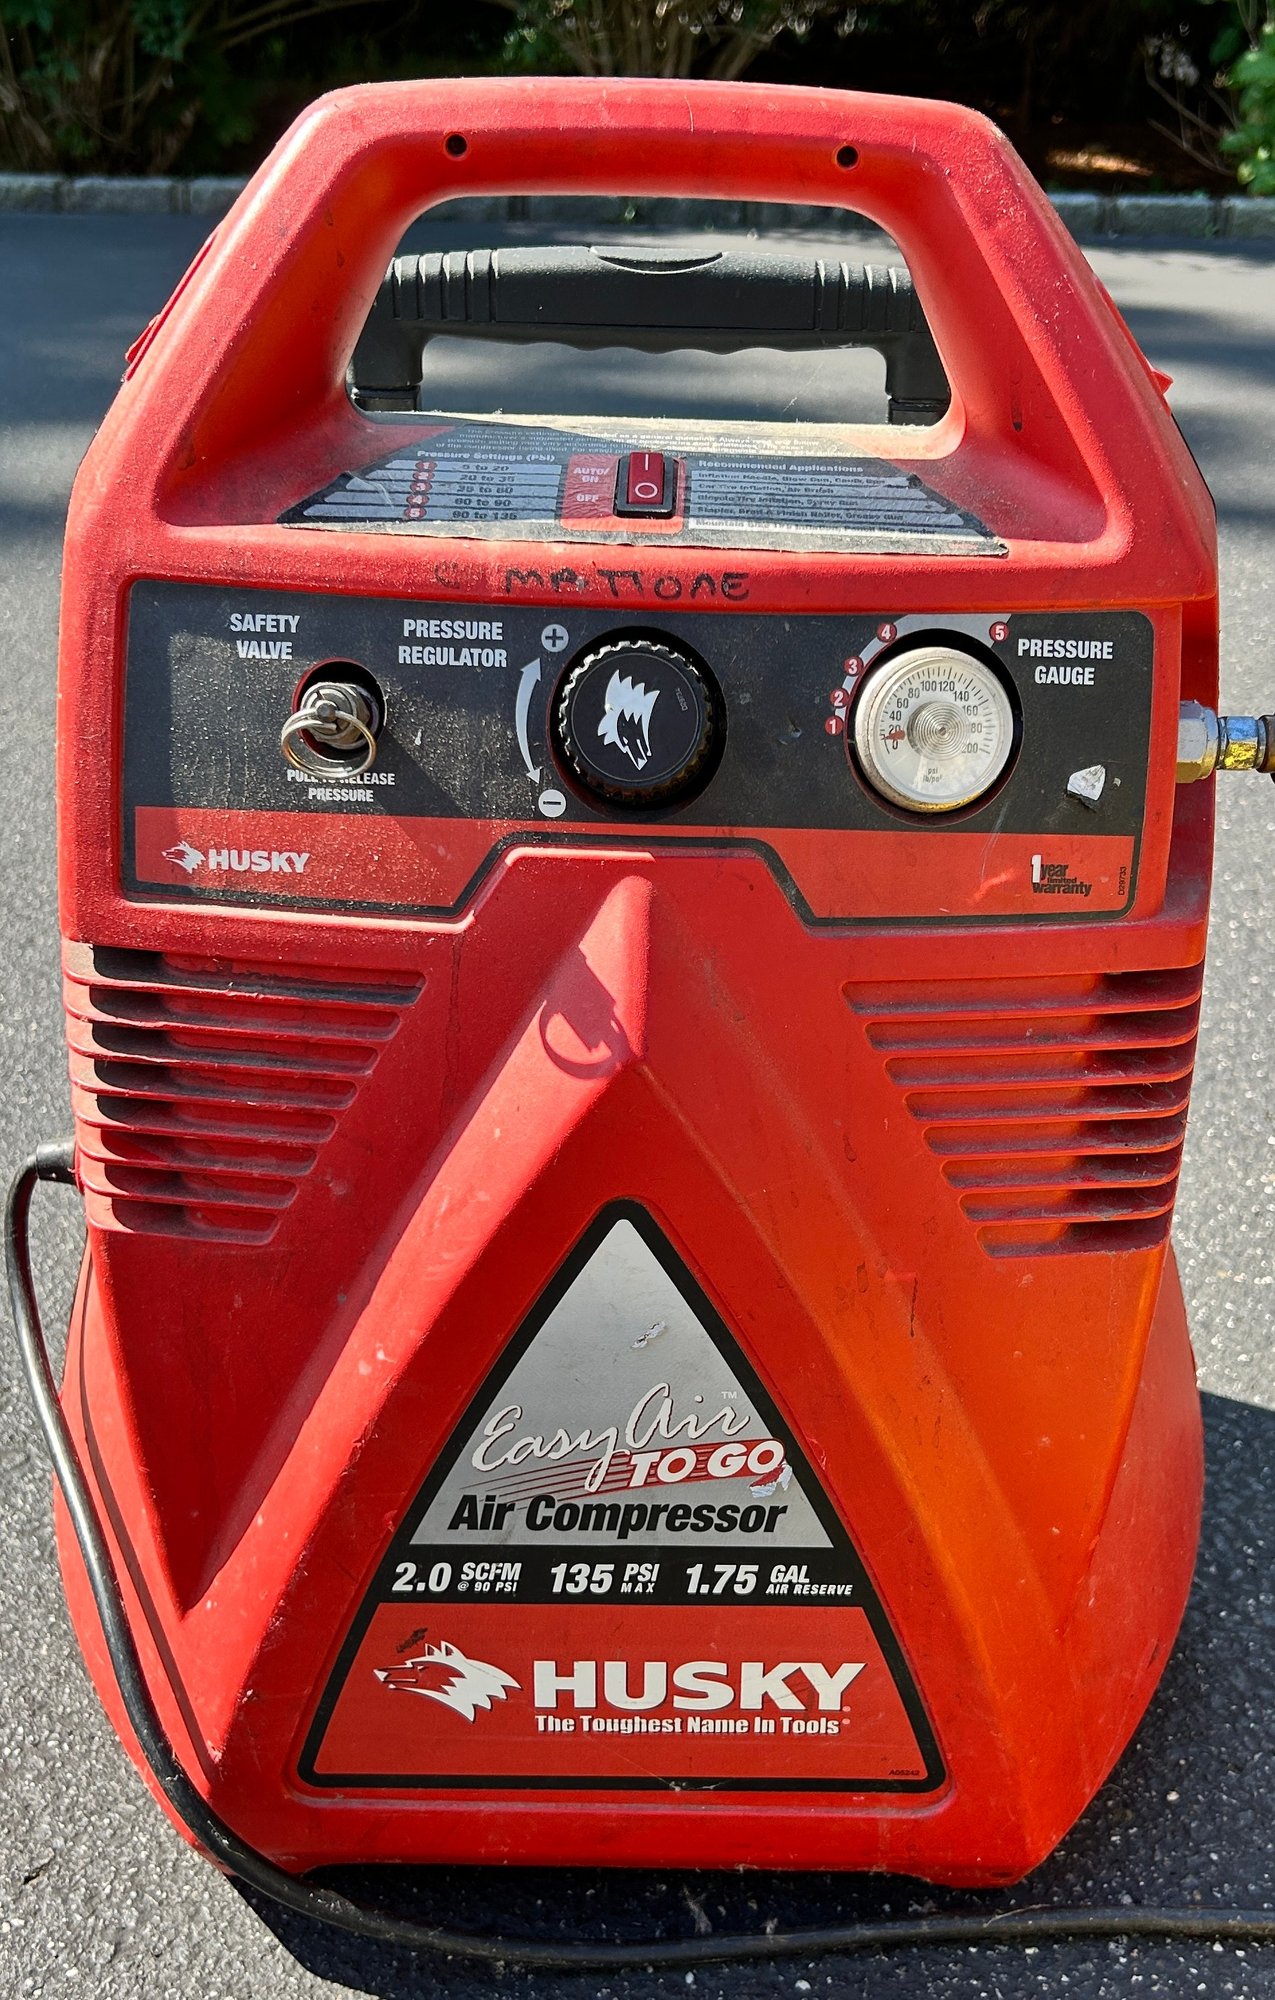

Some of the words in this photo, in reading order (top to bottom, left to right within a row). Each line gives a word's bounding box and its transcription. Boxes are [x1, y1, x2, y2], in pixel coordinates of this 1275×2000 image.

[417, 450, 471, 459] Pressure
[474, 452, 523, 462] Settings
[526, 454, 556, 463] (PSI)
[573, 467, 610, 475] AUTO/
[698, 460, 786, 470] Recommended
[789, 464, 864, 473] Applications
[581, 475, 599, 483] ON
[476, 498, 490, 507] to
[576, 493, 599, 502] OFF
[474, 511, 488, 520] to
[230, 613, 300, 633] SAFETY
[402, 618, 503, 641] PRESSURE
[236, 640, 293, 660] VALVE
[1017, 638, 1114, 660] PRESSURE
[398, 645, 508, 668] REGULATOR
[1034, 666, 1096, 686] GAUGE
[907, 687, 921, 699] 80
[921, 680, 937, 692] 100
[938, 680, 955, 692] 120
[896, 697, 909, 709] 60
[954, 690, 970, 702] 140
[889, 710, 902, 722] 40
[962, 704, 978, 717] 160
[967, 722, 983, 734] 80
[892, 739, 899, 750] 0
[928, 767, 938, 776] psi
[340, 772, 396, 786] ELEASE
[308, 787, 374, 802] PRESSURE
[208, 849, 311, 873] HUSKY
[1031, 854, 1042, 883] 1
[1040, 863, 1069, 880] year
[1032, 882, 1092, 897] warranty
[471, 1405, 618, 1493] Easy
[624, 1383, 752, 1449] Air
[627, 1448, 697, 1489] TO
[707, 1440, 786, 1478] GO
[448, 1494, 516, 1530] Air
[525, 1494, 788, 1540] Compressor
[391, 1562, 453, 1593] 2.0
[461, 1562, 522, 1581] SCFM
[550, 1563, 616, 1594] 135
[623, 1563, 660, 1582] PSI
[684, 1564, 760, 1595] 1.75
[770, 1564, 810, 1584] GAL
[457, 1581, 469, 1593] @
[474, 1581, 492, 1593] 90
[495, 1581, 518, 1593] PSI
[765, 1584, 790, 1595] AIR
[793, 1584, 853, 1596] RESERVE
[533, 1660, 868, 1712] HUSKY
[535, 1714, 575, 1734] The
[580, 1715, 682, 1736] Toughest
[686, 1716, 750, 1735] Name
[753, 1716, 776, 1735] In
[780, 1716, 840, 1736] Tools
